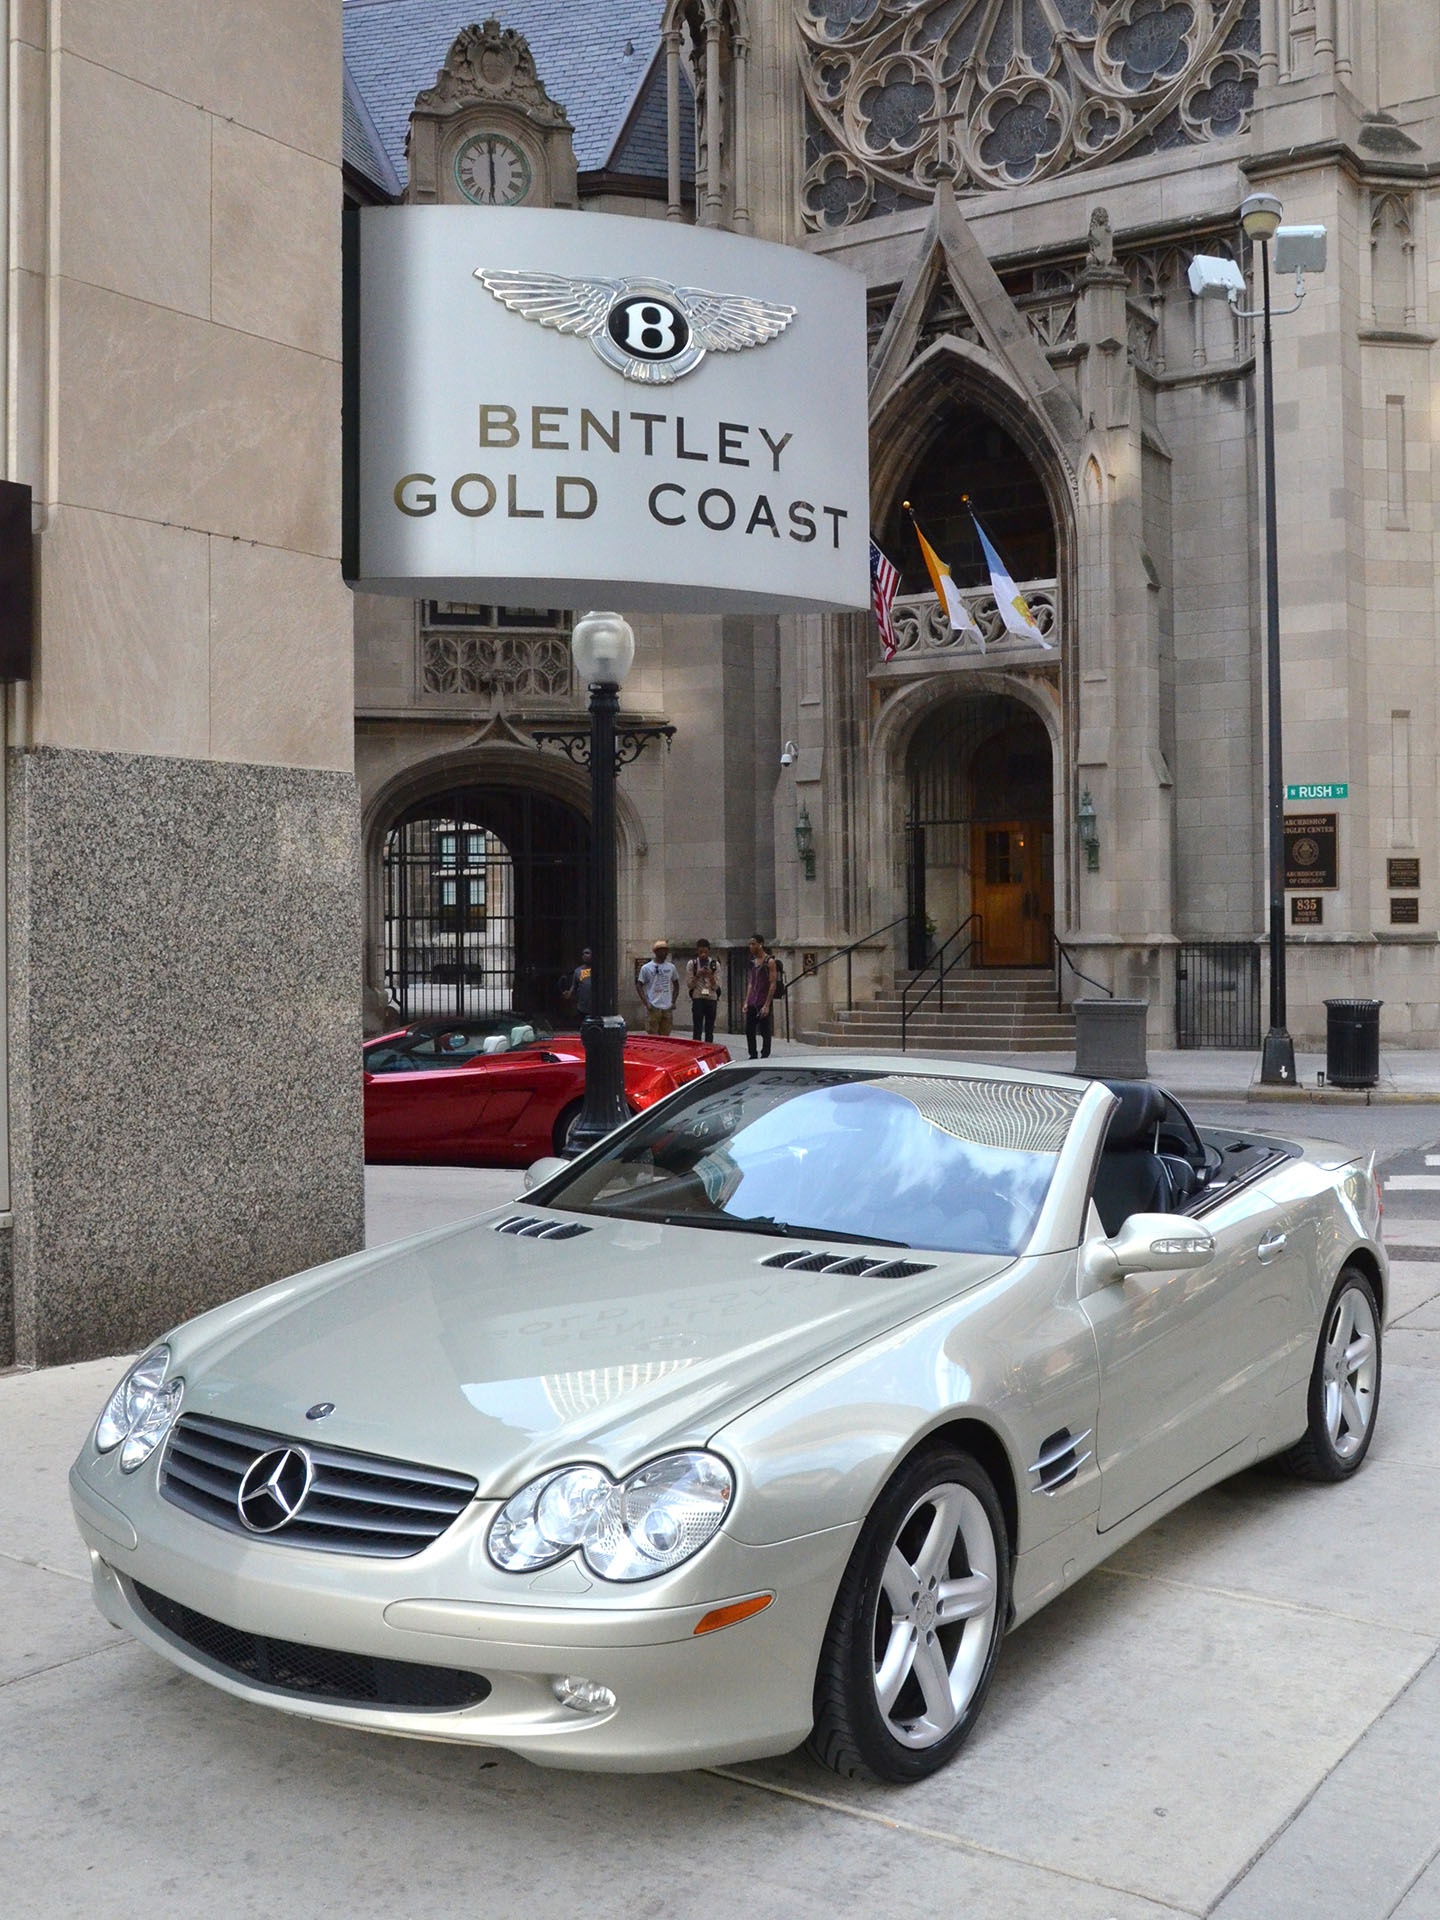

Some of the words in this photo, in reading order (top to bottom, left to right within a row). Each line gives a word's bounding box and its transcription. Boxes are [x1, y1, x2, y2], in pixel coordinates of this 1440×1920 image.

[478, 403, 794, 472] BENTLEY
[392, 473, 598, 520] GOLD
[648, 482, 848, 549] COAST
[1299, 785, 1332, 798] RUSH
[1336, 787, 1344, 795] ST
[1296, 899, 1317, 910] 835
